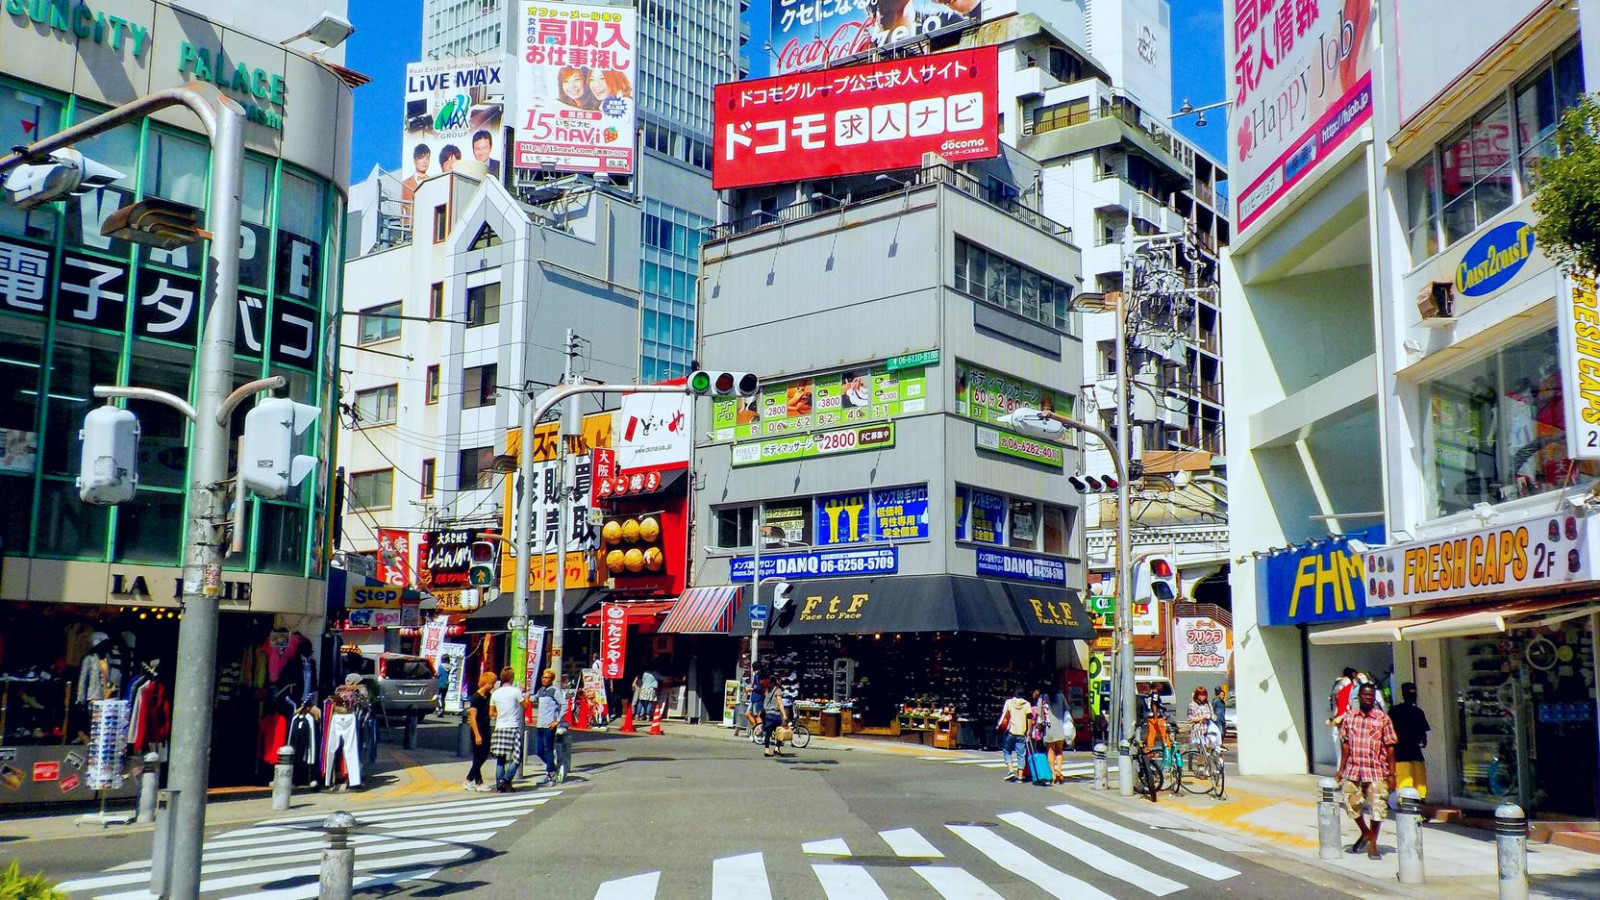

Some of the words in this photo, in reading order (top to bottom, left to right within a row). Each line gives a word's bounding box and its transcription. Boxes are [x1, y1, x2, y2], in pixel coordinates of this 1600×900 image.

[527, 7, 622, 22] オファーメールあり
[527, 17, 536, 44] 女性の
[538, 18, 630, 50] 高収入
[525, 45, 630, 70] お仕事探し
[178, 41, 287, 106] PALACE
[456, 66, 501, 88] MAX
[1251, 64, 1311, 149] Happy
[1318, 9, 1354, 98] Job
[740, 60, 968, 108] ドコモグループ公式求人サイト
[522, 109, 556, 140] 15
[440, 131, 469, 140] GROUP
[941, 138, 985, 150] docomo
[974, 408, 983, 417] 3F
[763, 441, 814, 455] ボディマッサージ
[1587, 430, 1600, 447] 2
[600, 472, 656, 493] たこ焼き
[877, 505, 904, 517] 低価格
[880, 515, 916, 526] 男性専用
[776, 556, 819, 575] DANQ
[820, 555, 894, 573] 06-6258-5709
[1003, 556, 1034, 577] DANQ
[1402, 535, 1467, 595] FRESH
[1469, 526, 1530, 585] CAPS
[1533, 542, 1556, 579] 2F
[111, 573, 154, 602] LA
[355, 589, 397, 604] Step
[800, 612, 822, 620] Face
[826, 612, 836, 620] to
[838, 611, 862, 619] Face
[1037, 617, 1053, 625] Face
[1063, 619, 1079, 627] Face
[1187, 629, 1223, 644] プリクラ
[607, 624, 622, 676] たこやき
